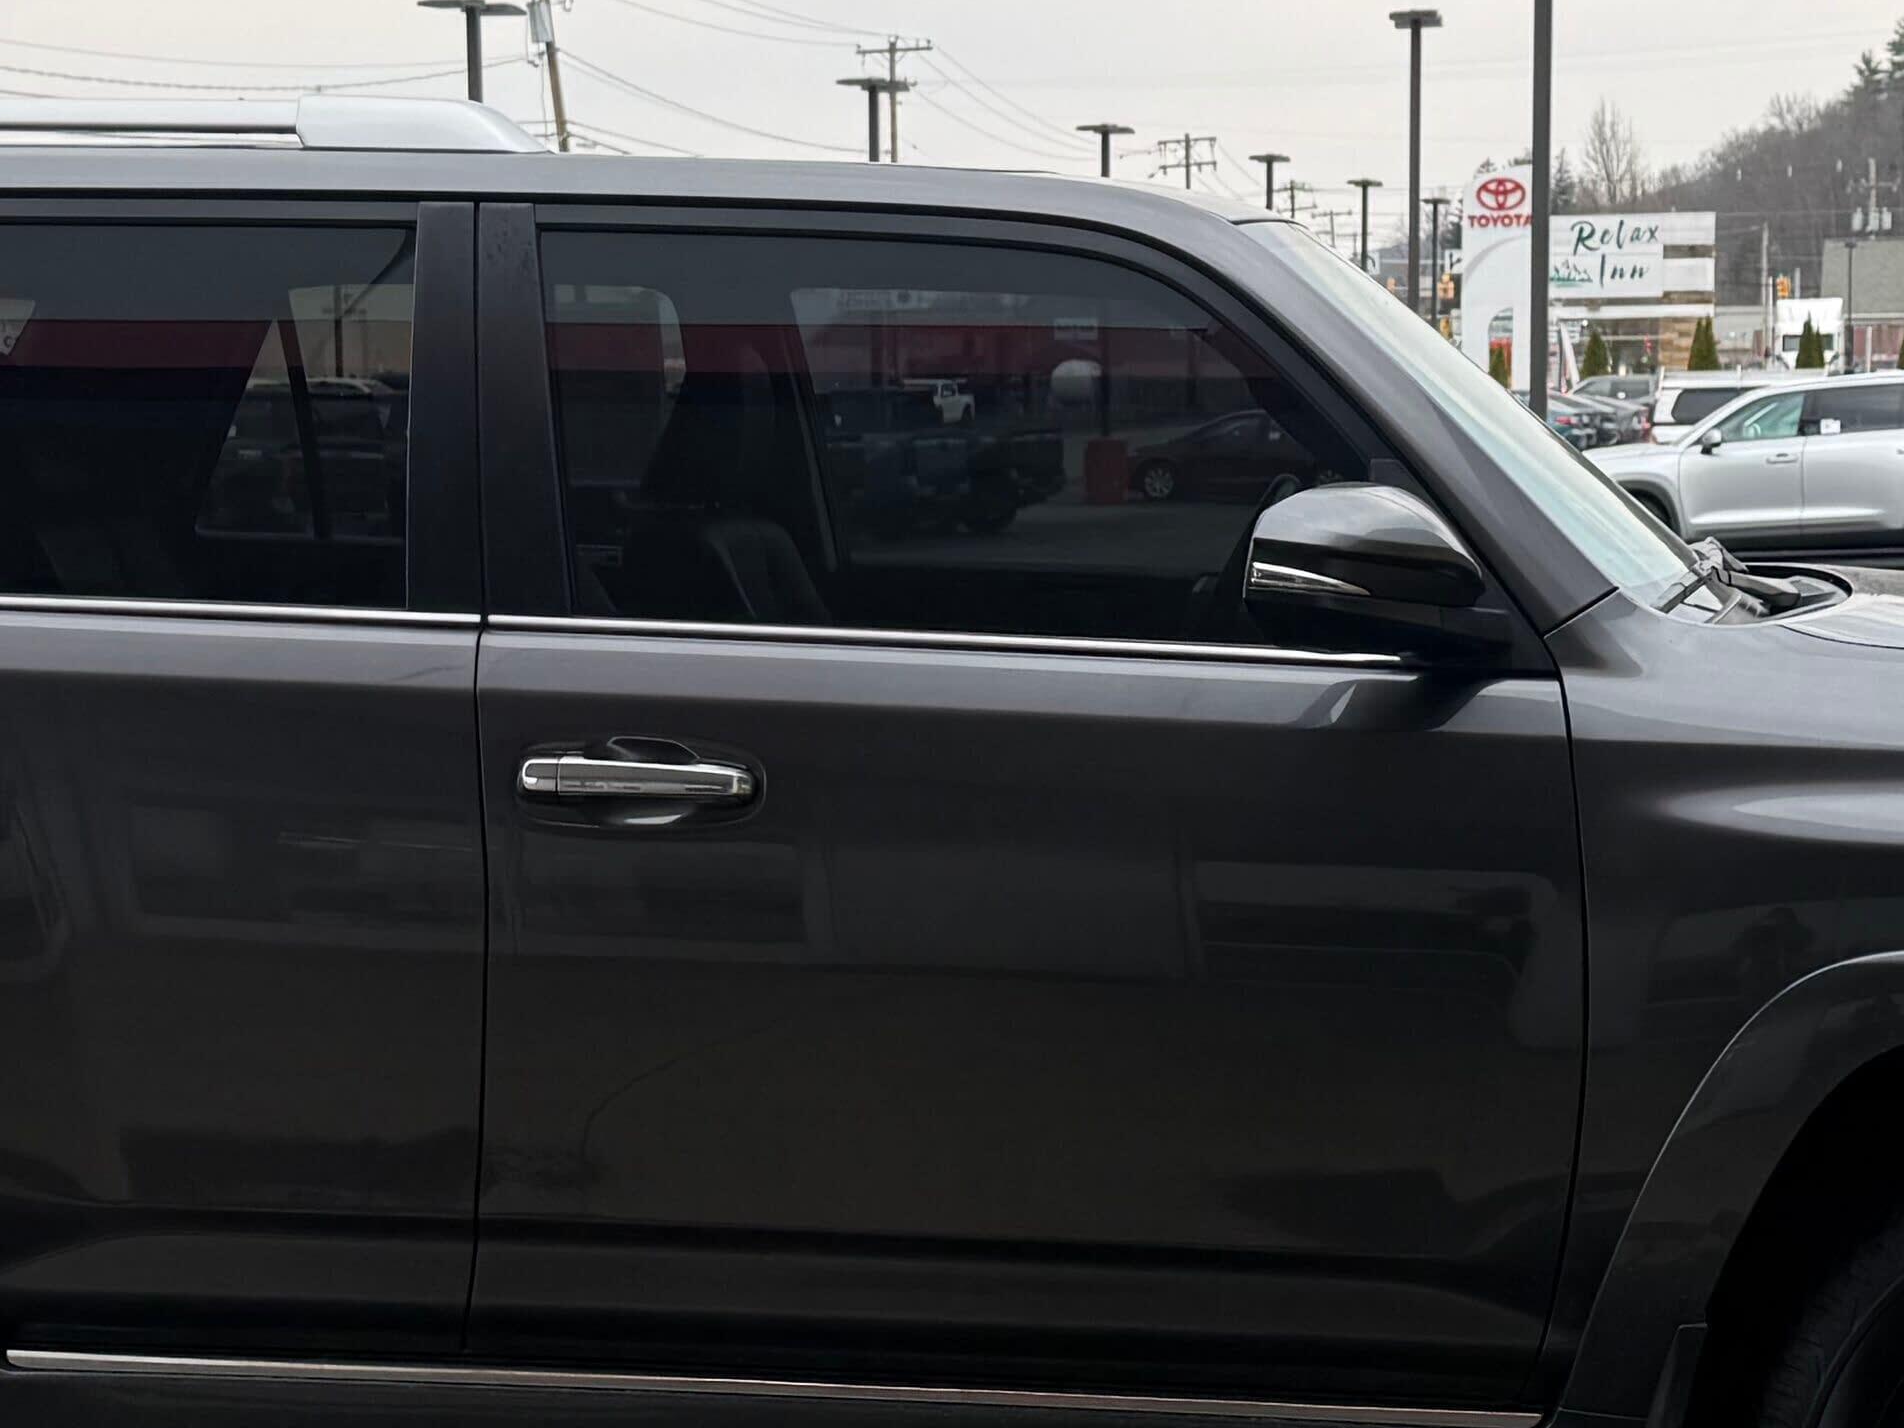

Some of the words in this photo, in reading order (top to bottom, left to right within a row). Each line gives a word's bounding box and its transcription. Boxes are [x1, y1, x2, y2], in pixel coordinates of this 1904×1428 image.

[1468, 213, 1534, 228] TOYOTA
[1571, 219, 1659, 256] Relax
[1599, 253, 1650, 289] Inn
